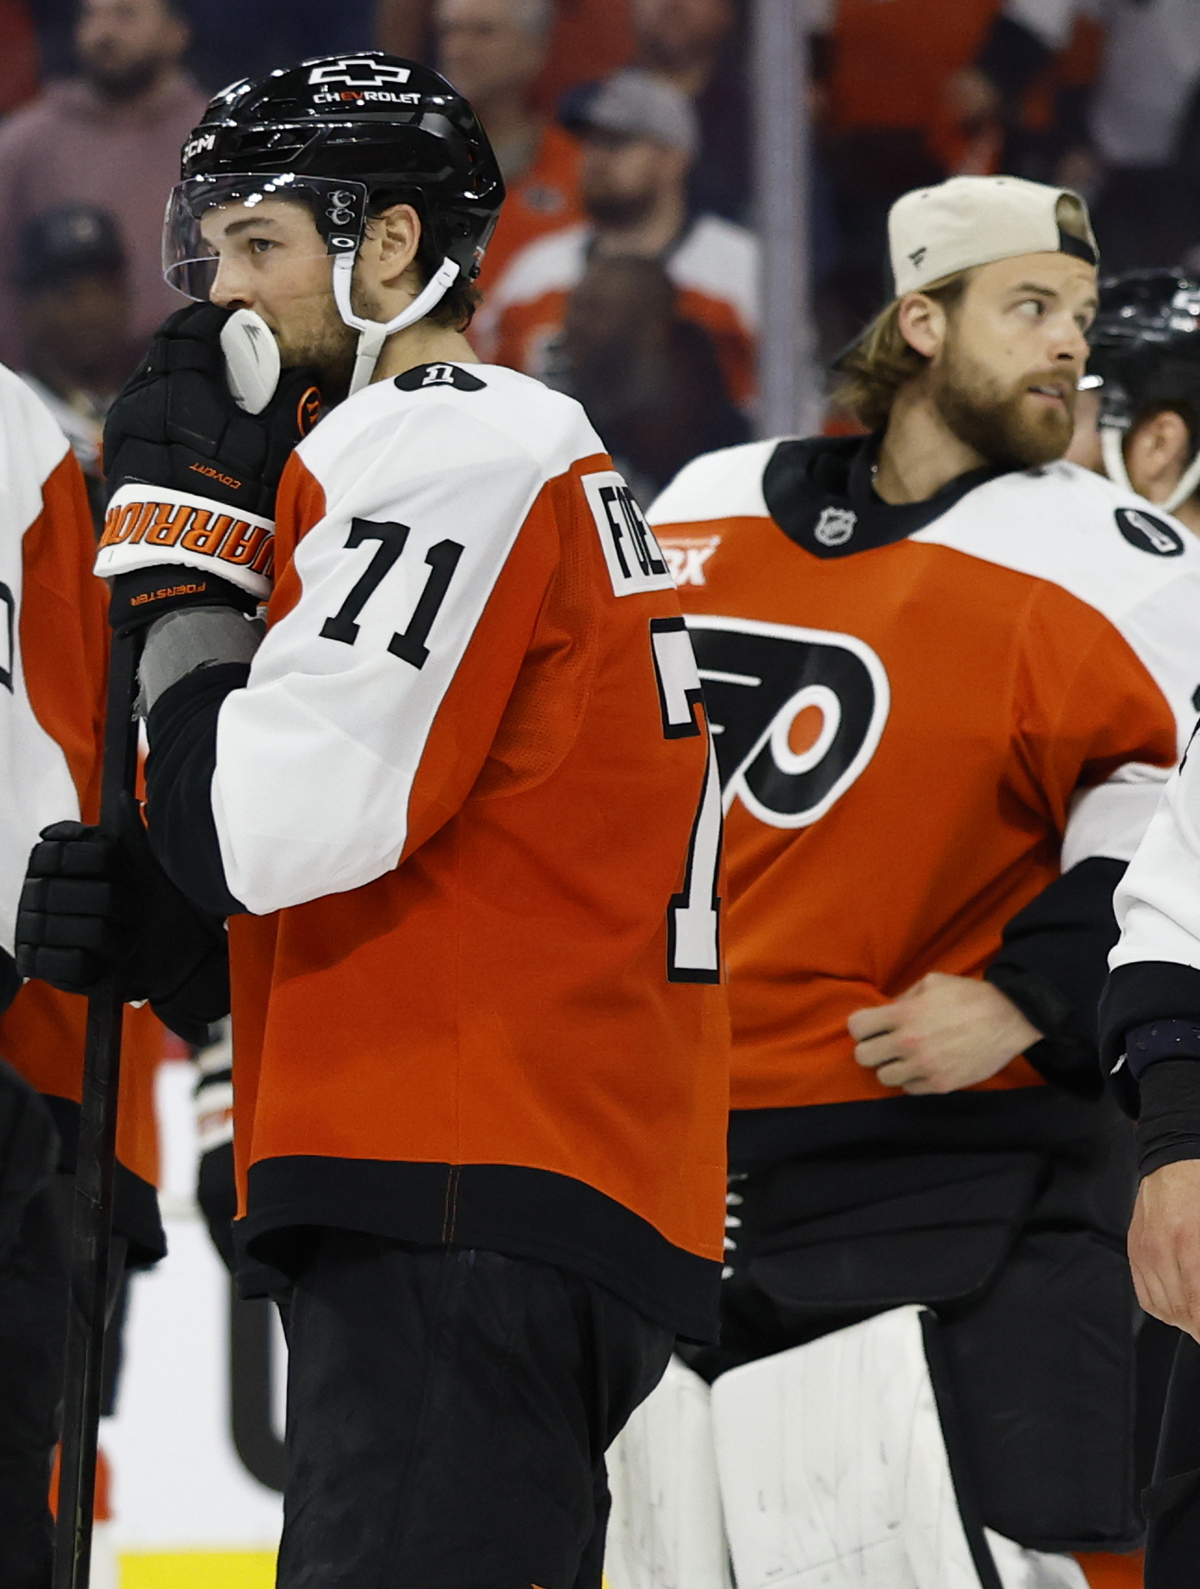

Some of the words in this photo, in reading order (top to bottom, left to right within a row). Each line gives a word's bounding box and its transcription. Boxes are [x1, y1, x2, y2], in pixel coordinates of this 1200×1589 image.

[313, 91, 421, 105] CHEVROLET
[189, 462, 242, 490] COVERT
[660, 548, 717, 586] BX
[318, 516, 466, 671] 71
